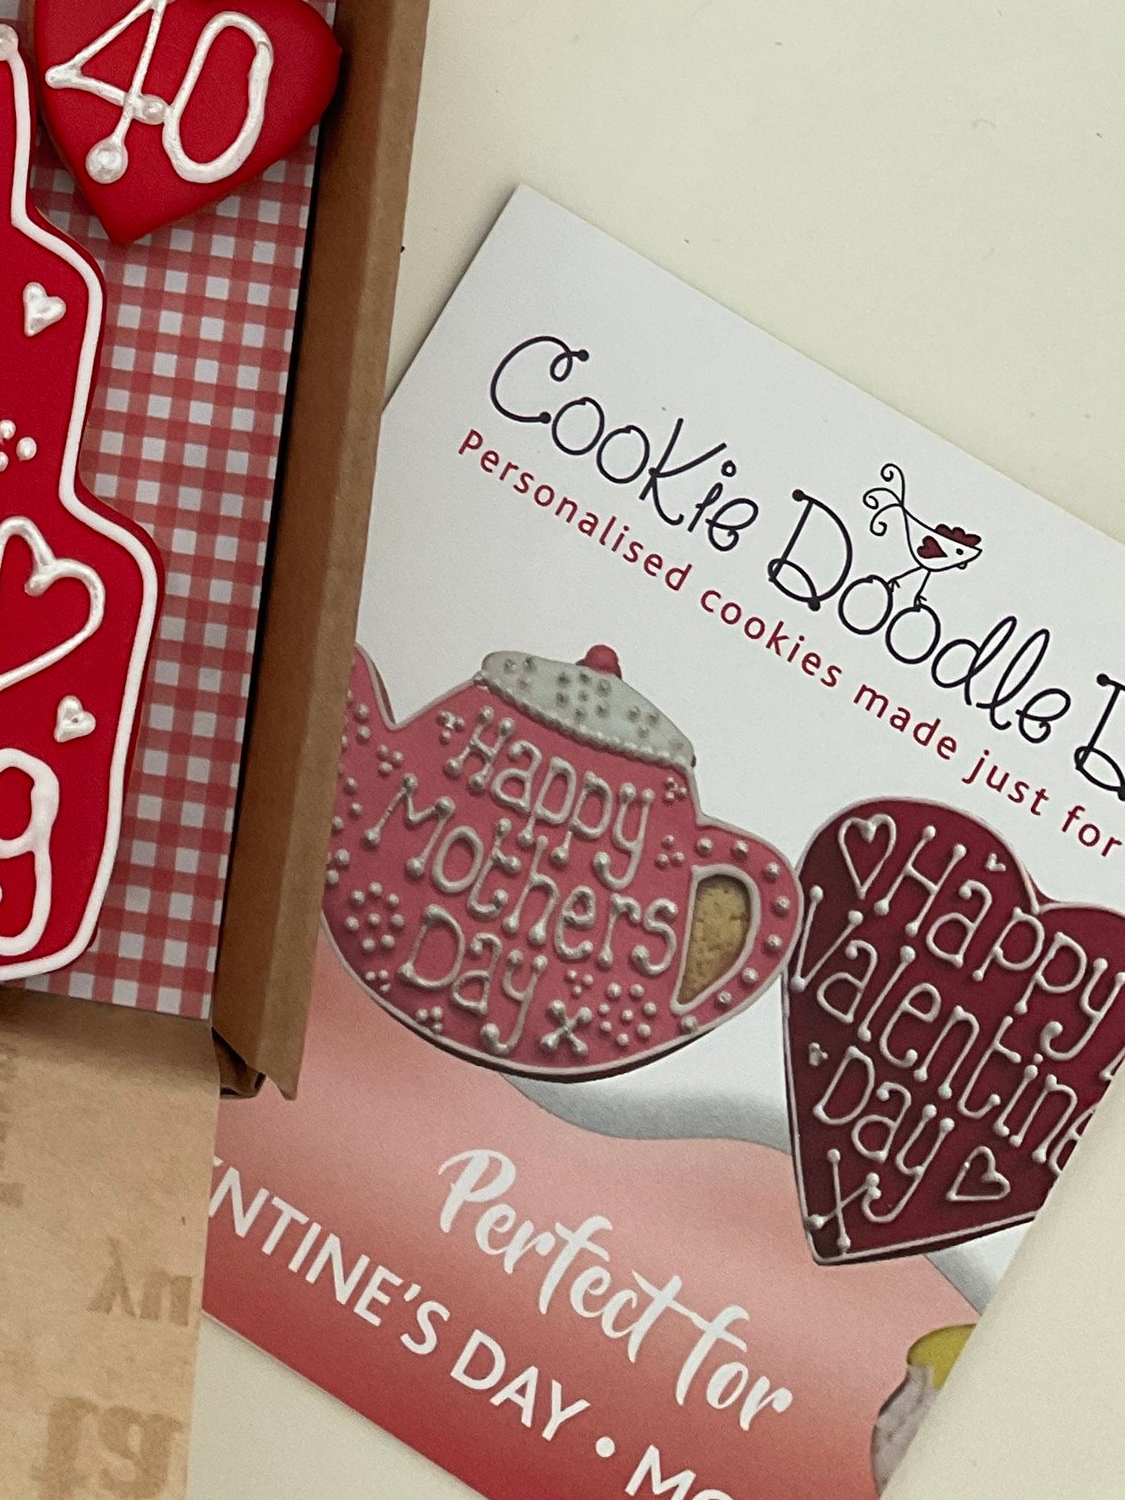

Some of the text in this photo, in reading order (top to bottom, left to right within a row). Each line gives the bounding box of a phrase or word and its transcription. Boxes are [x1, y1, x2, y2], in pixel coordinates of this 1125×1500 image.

[457, 428, 1123, 858] Personalised cookies made just for
[767, 488, 1071, 744] Doodle
[364, 772, 678, 976] Mothers
[443, 705, 655, 891] Happy
[397, 903, 548, 1056] Day
[875, 825, 1125, 1061] Happy
[813, 1045, 955, 1224] Day
[209, 1155, 450, 1357] NTINE'S
[449, 1328, 591, 1442] DAY
[437, 1148, 793, 1431] Perfect for
